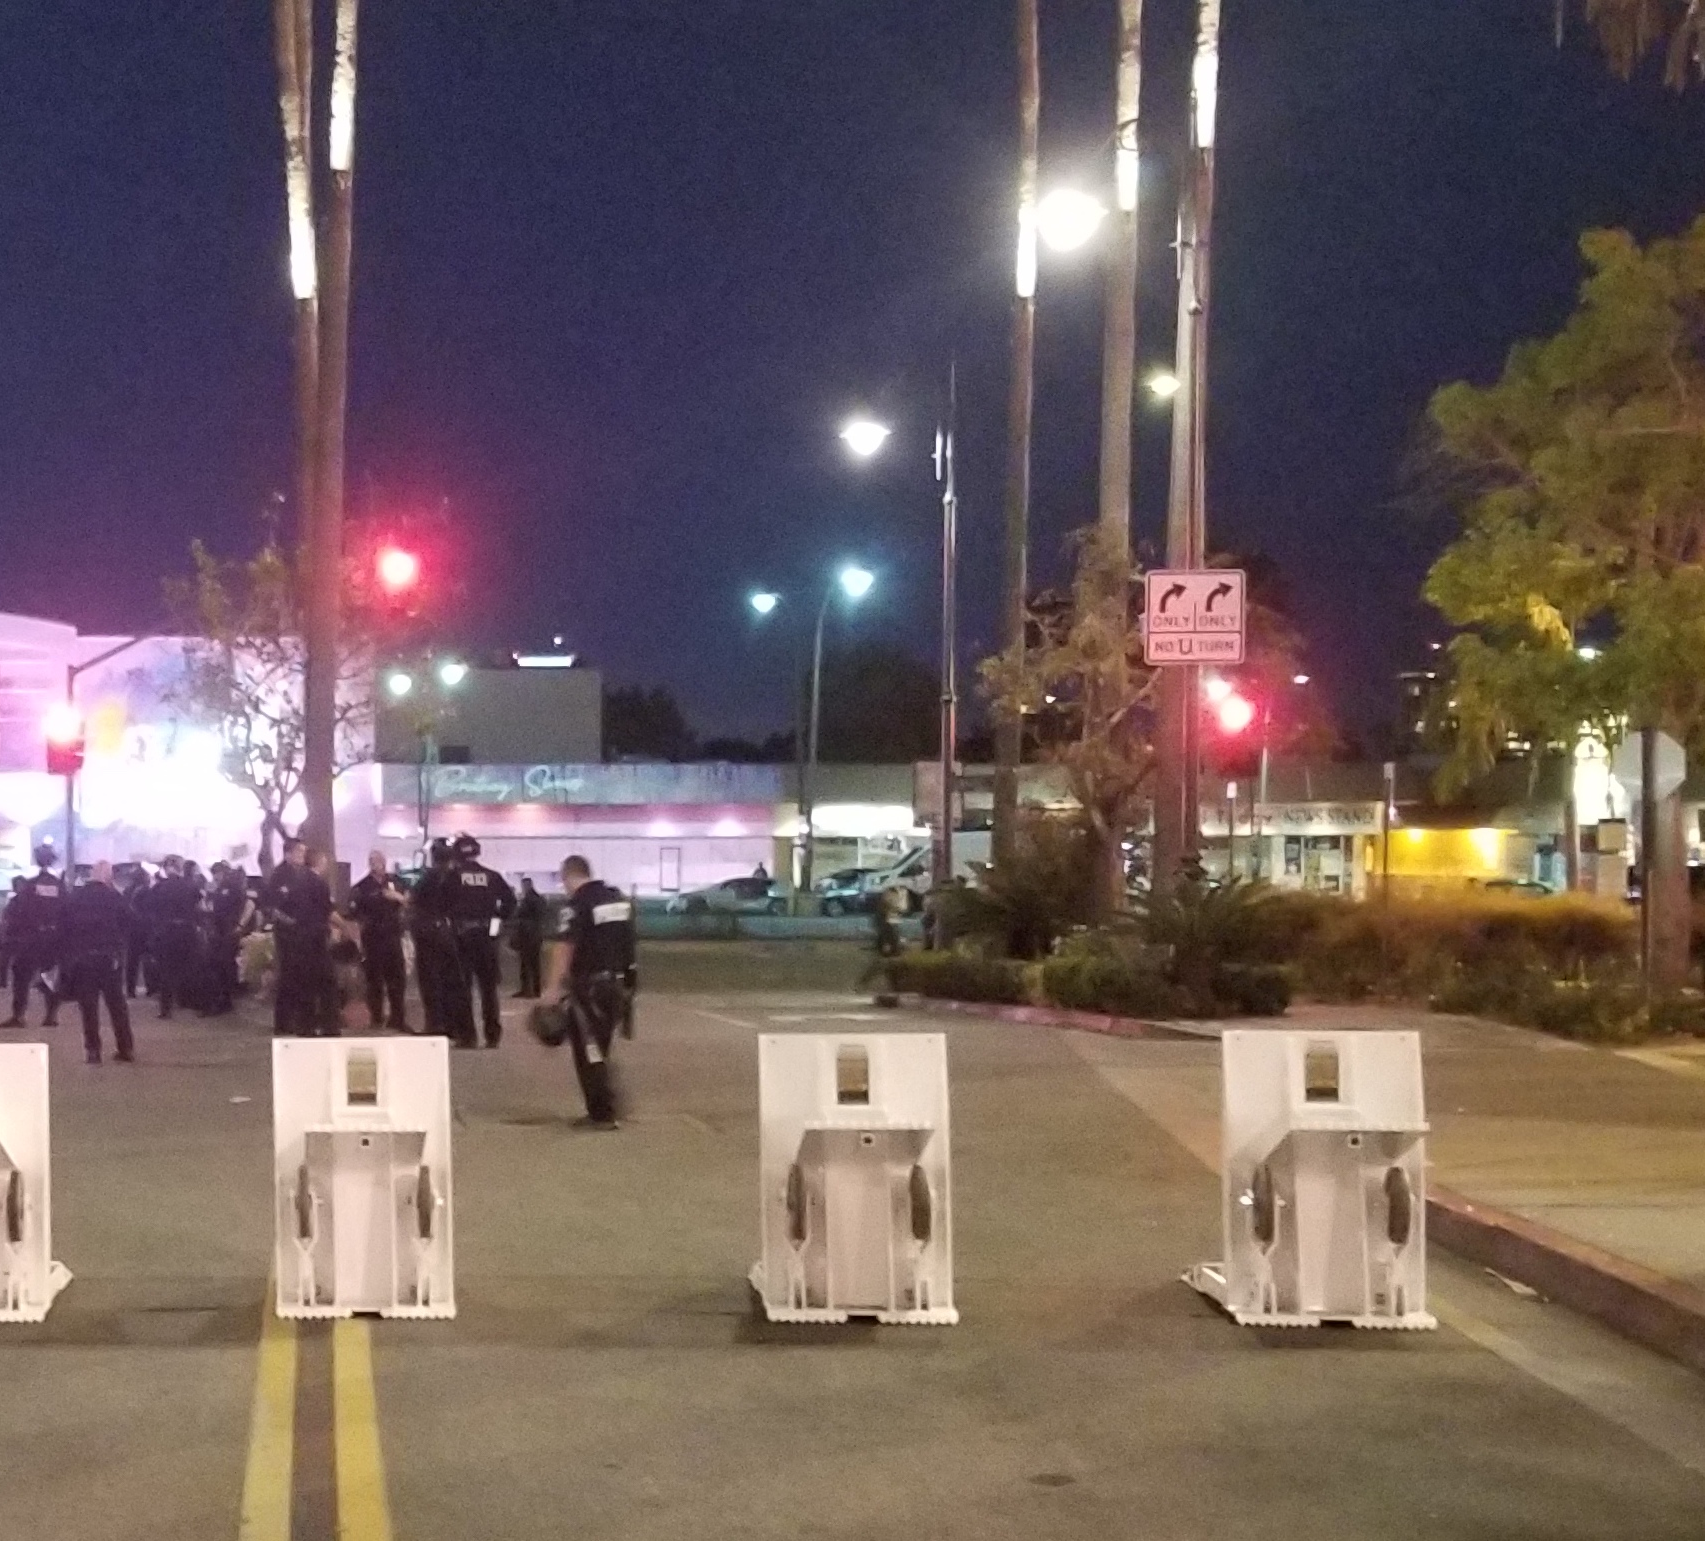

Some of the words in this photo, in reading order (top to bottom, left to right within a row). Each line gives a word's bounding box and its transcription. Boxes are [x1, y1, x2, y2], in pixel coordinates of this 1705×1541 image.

[1152, 614, 1191, 628] ONLY
[1198, 614, 1237, 628] ONLY
[1155, 641, 1175, 653] NO
[1178, 638, 1193, 656] U
[1197, 641, 1235, 653] TURN
